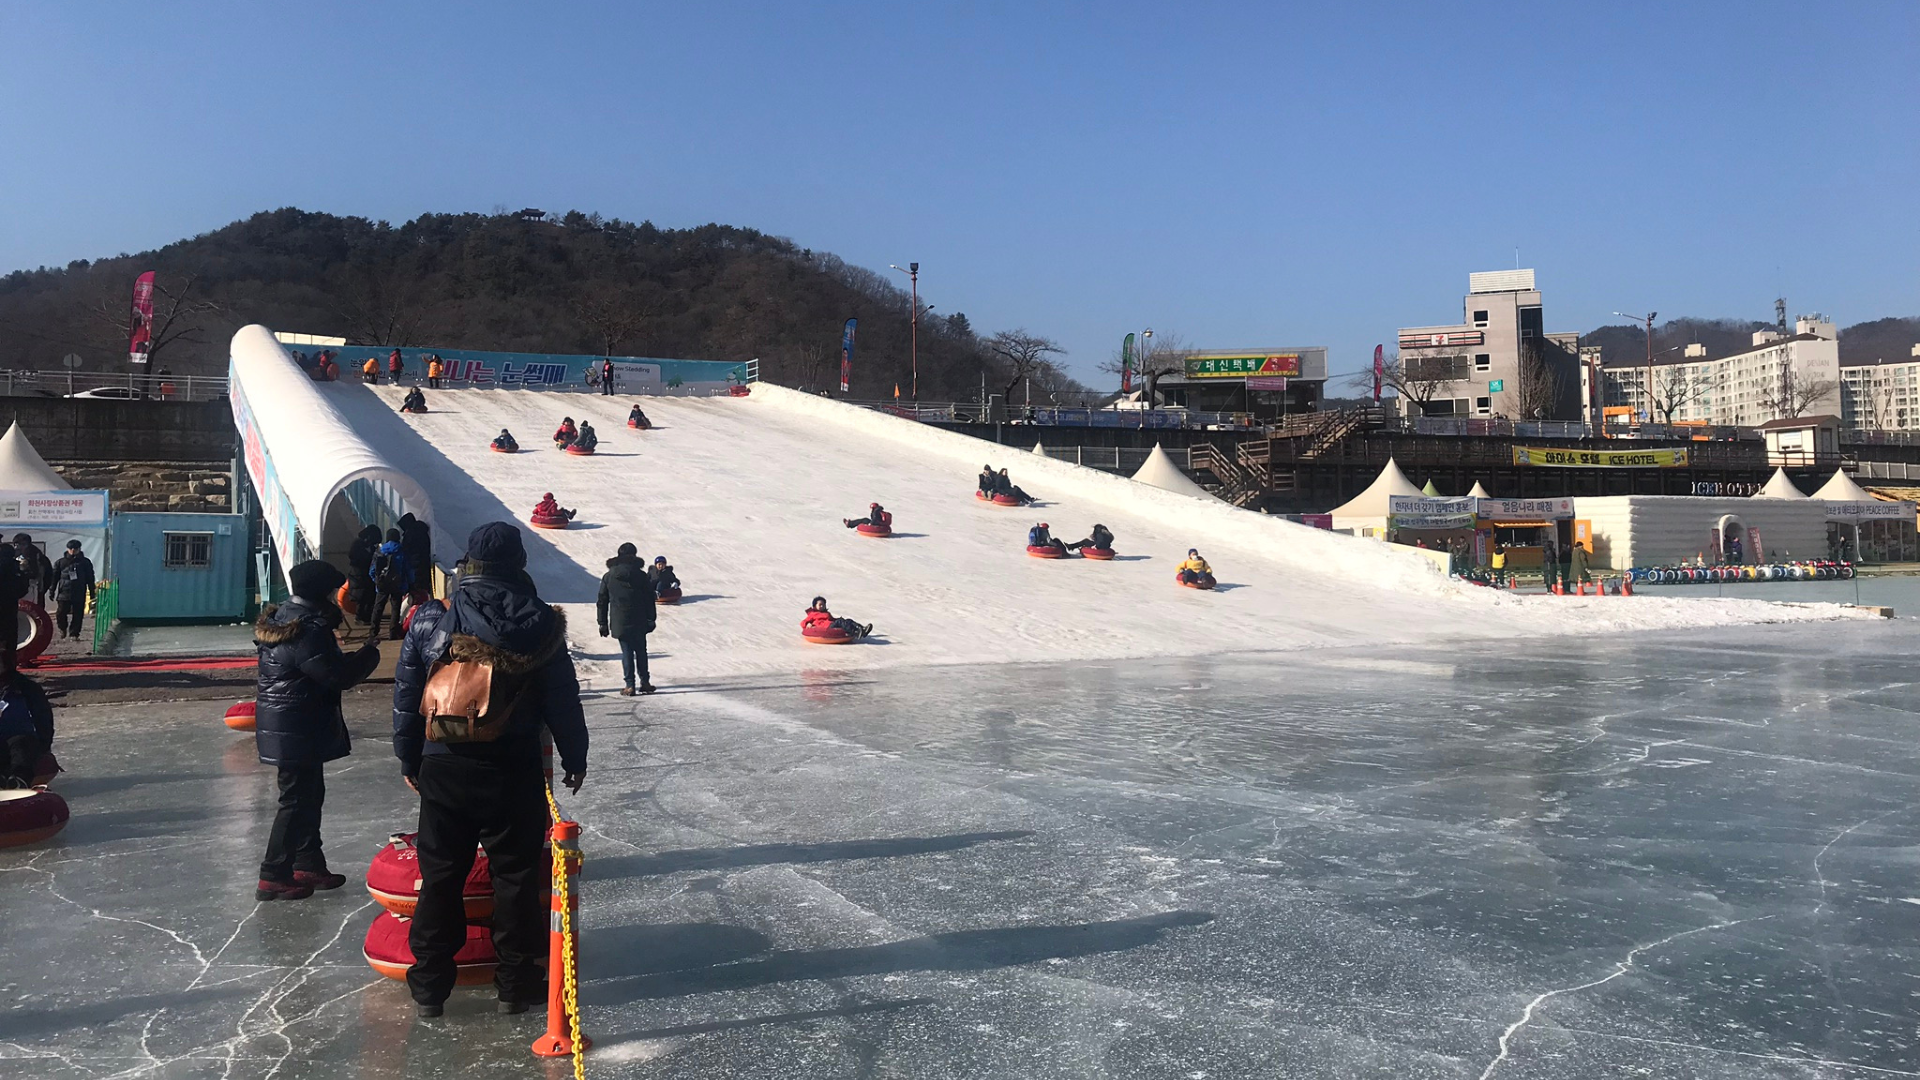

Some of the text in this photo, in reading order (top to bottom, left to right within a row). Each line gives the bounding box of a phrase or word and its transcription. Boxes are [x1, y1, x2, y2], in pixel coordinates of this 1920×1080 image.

[1206, 358, 1256, 372] 대신택배
[500, 361, 568, 385] 눈썰매
[1546, 452, 1659, 465] 아이스 호텔 ICE HOTEL
[1396, 502, 1413, 513] 한자녀
[1414, 502, 1421, 513] 더
[1421, 502, 1434, 513] 갖기
[1435, 502, 1455, 513] 캠페인
[1456, 502, 1470, 513] 홍보
[1502, 501, 1535, 513] 얼음나라
[1536, 501, 1553, 513] 매점
[1866, 506, 1882, 515] PEACE
[1882, 506, 1900, 515] COFFEE
